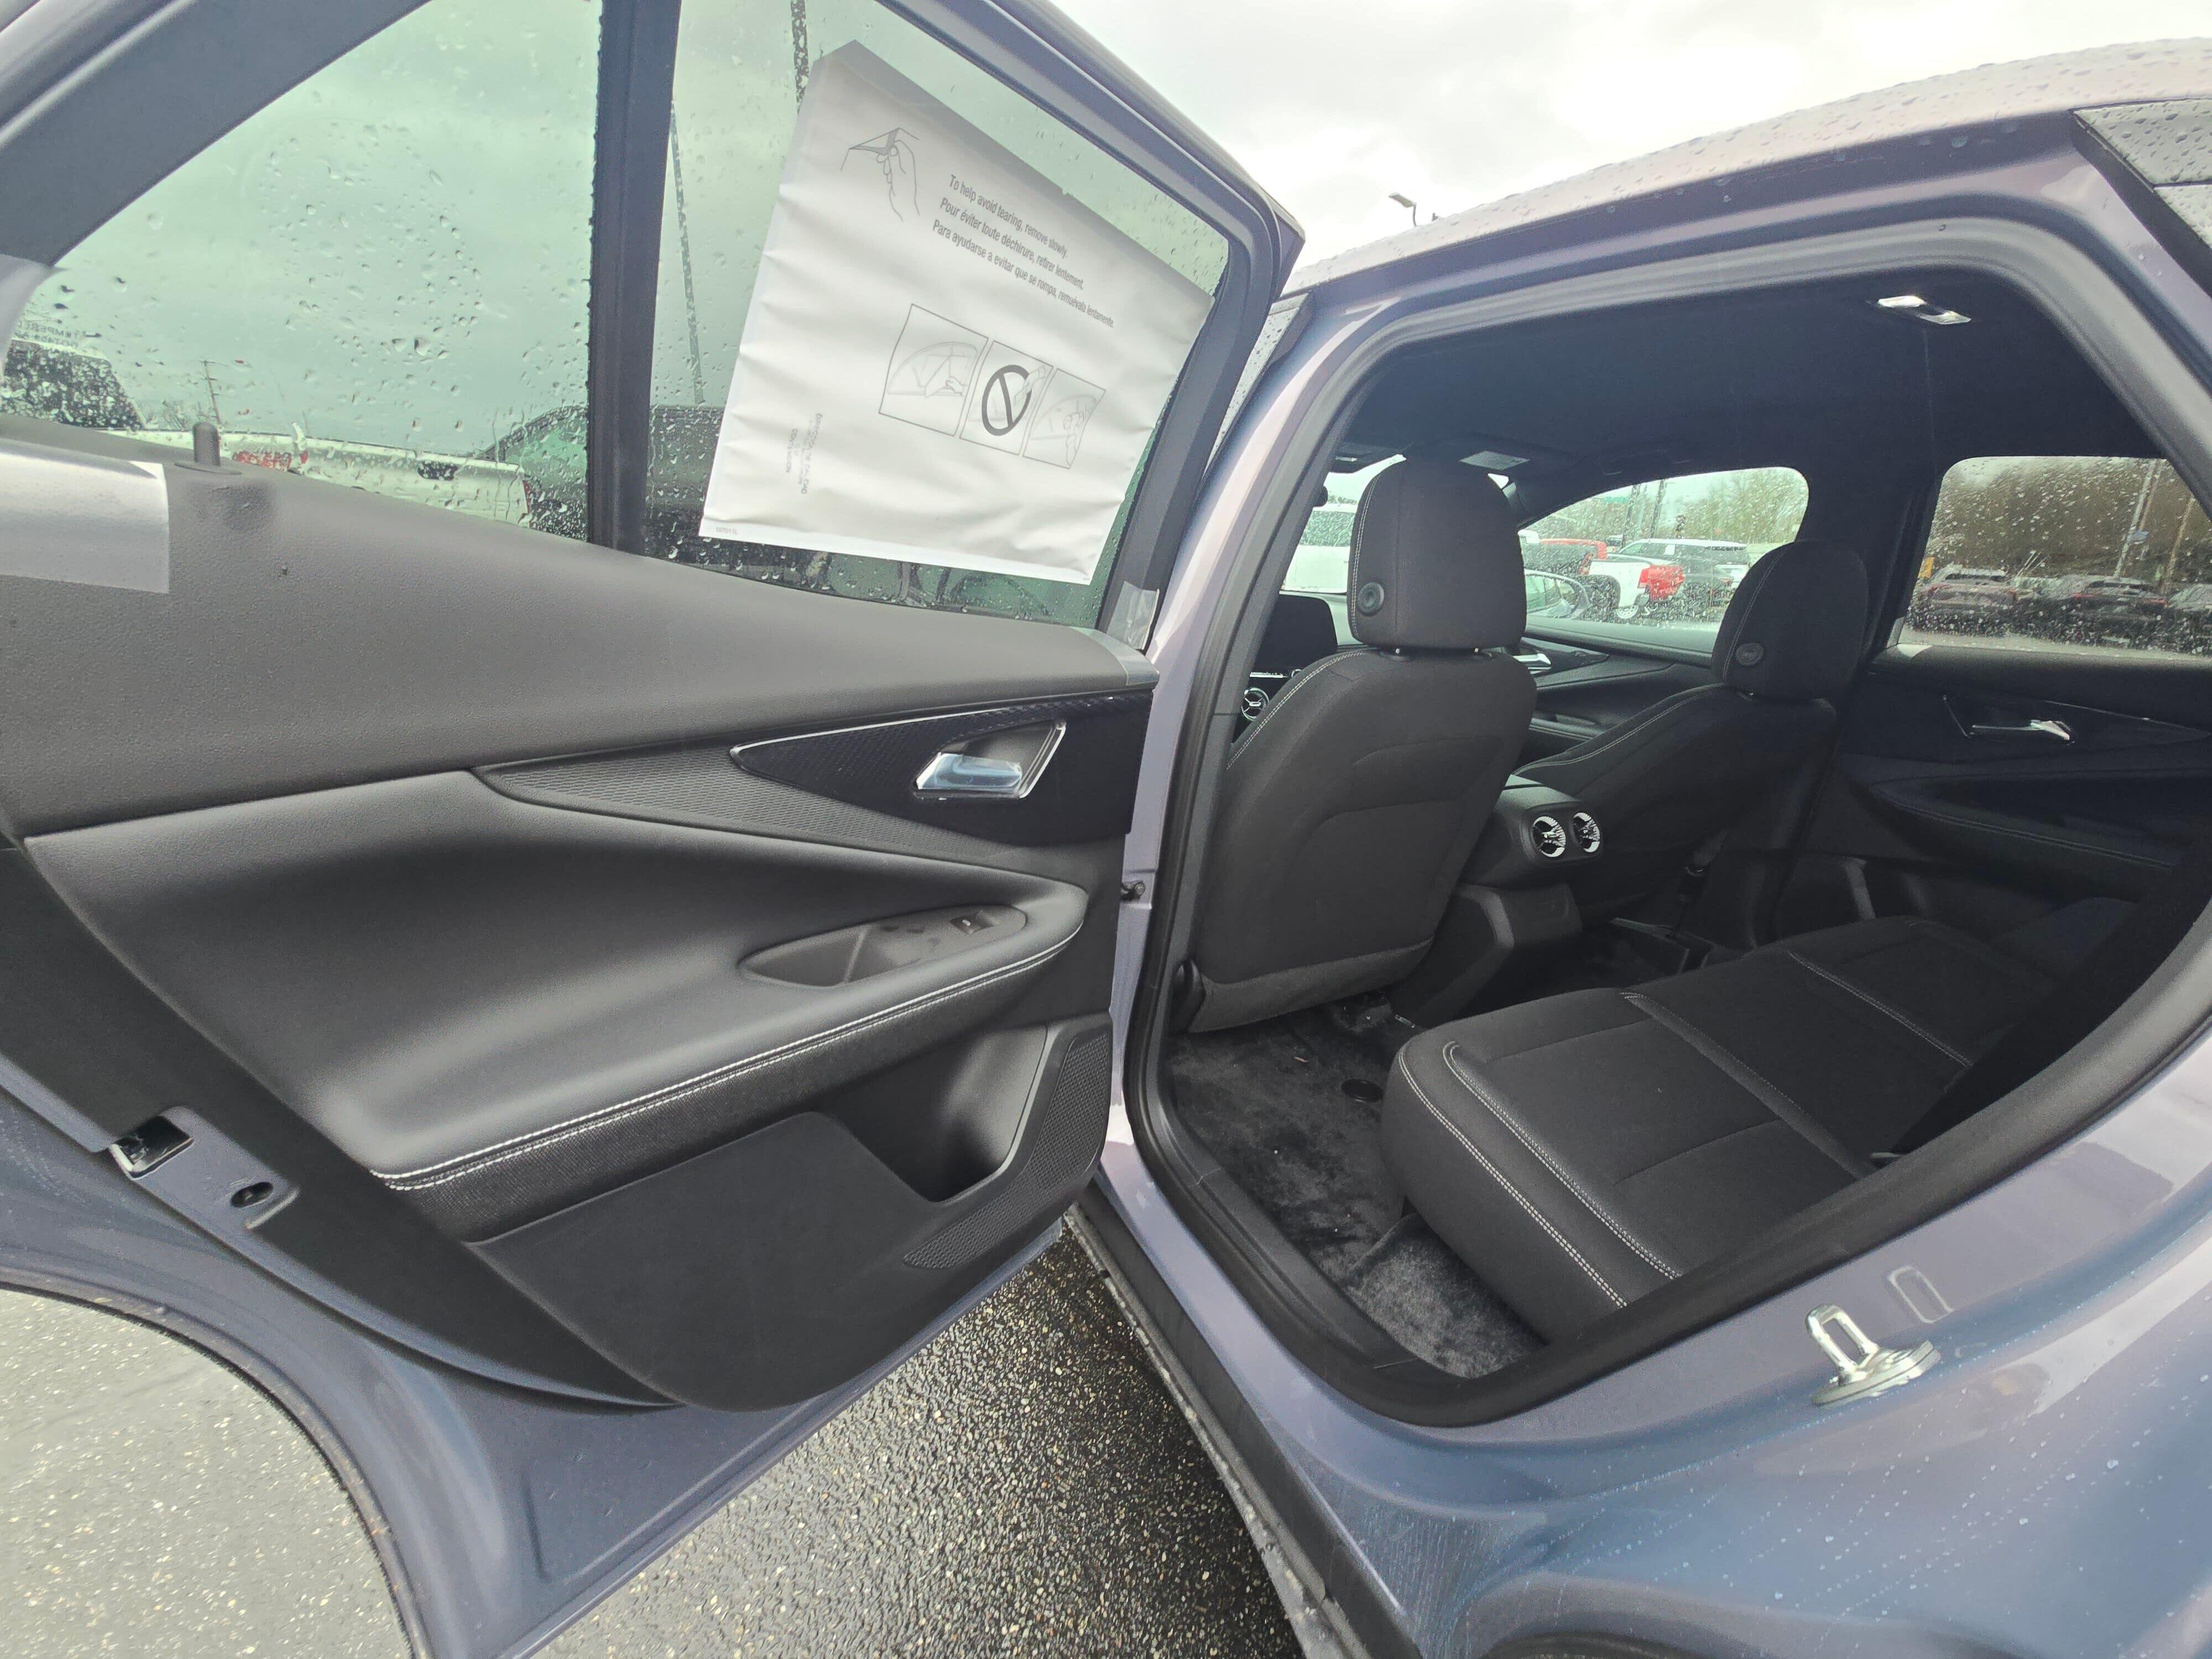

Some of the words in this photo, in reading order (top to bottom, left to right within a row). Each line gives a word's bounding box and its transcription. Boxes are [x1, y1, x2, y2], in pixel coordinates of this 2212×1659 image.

[940, 197, 961, 217] Pour
[960, 209, 982, 230] éviter
[982, 222, 1000, 241] toute
[1001, 234, 1035, 263] déchirure,
[1036, 255, 1056, 273] retirer
[1055, 264, 1084, 290] lentement.
[950, 174, 959, 190] To
[960, 181, 977, 203] help
[977, 195, 998, 213] avoid
[997, 205, 1023, 232] tearing,
[1025, 223, 1048, 245] remove
[1048, 238, 1068, 259] slowly.
[932, 219, 951, 239] Para
[952, 232, 987, 258] ayudarse
[988, 252, 993, 262] a
[994, 255, 1014, 273] evitar
[1015, 266, 1028, 280] que
[1028, 274, 1036, 285] se
[1037, 279, 1057, 299] rompa,
[1058, 290, 1086, 314] remuévala
[1086, 305, 1114, 328] lentamente.
